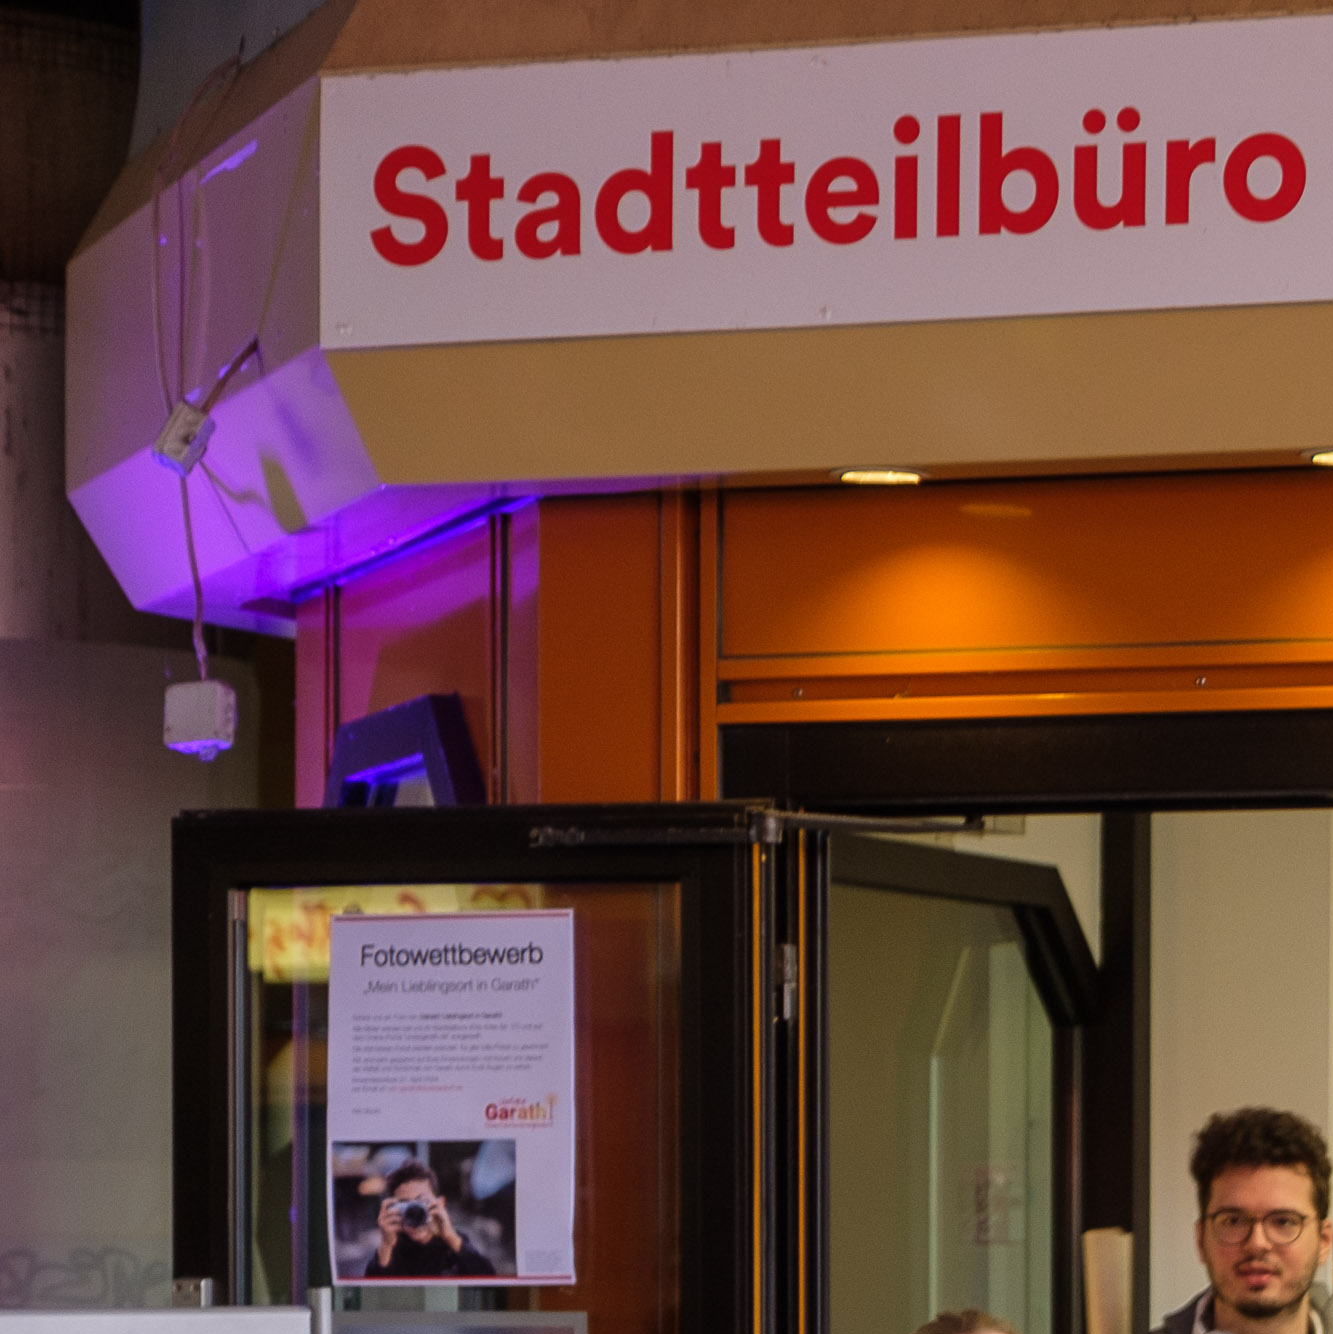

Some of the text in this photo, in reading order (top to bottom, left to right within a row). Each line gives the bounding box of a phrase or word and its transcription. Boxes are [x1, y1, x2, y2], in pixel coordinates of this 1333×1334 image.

[370, 107, 1307, 267] Stadtteilbüro
[359, 941, 544, 968] Fotowettbewerb
[401, 978, 473, 995] Lieblingsort
